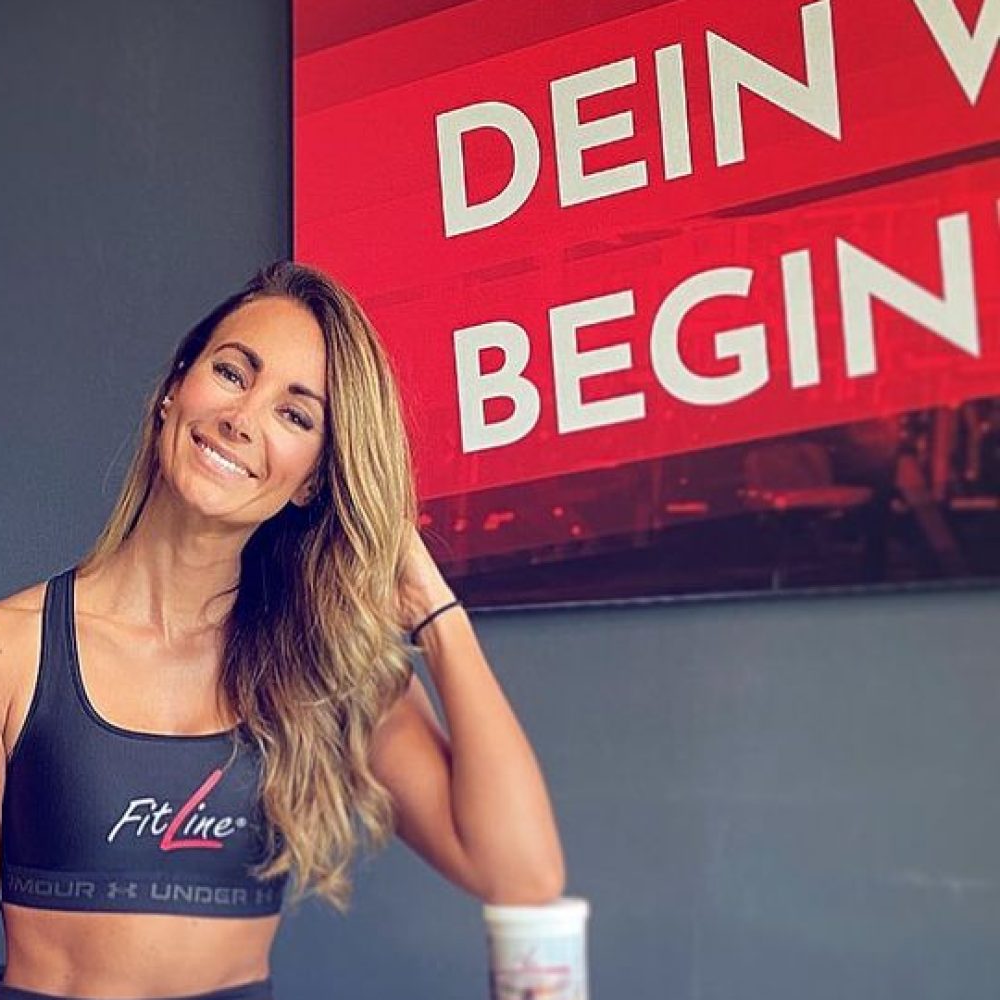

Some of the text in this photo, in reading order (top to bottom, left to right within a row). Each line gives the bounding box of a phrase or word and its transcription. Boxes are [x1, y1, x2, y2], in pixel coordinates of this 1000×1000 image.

[435, 0, 842, 238] DEIN
[452, 198, 1000, 454] BEGIN
[151, 882, 247, 905] UNDER
